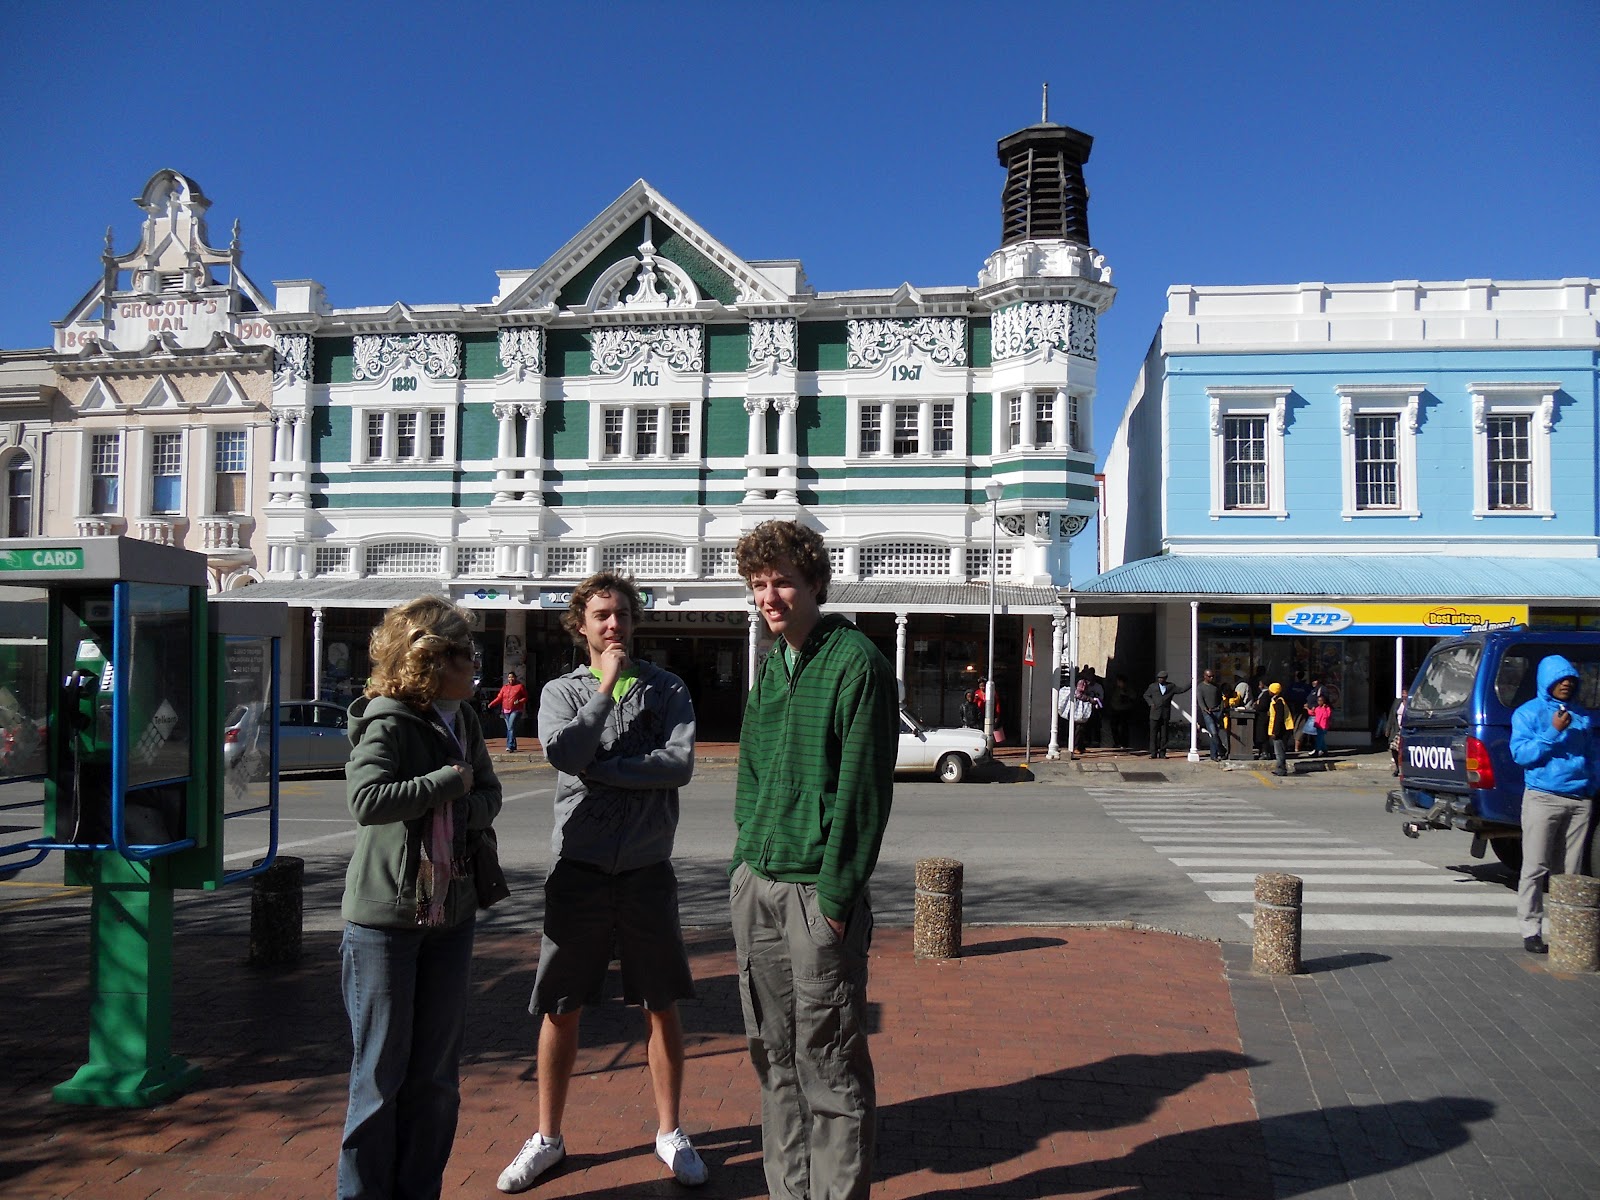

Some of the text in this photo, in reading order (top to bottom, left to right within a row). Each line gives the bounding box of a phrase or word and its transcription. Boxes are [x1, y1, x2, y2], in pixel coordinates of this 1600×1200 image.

[120, 299, 218, 319] GROCOTT'S
[148, 317, 188, 331] MAIL
[236, 322, 272, 340] 1906
[892, 364, 922, 381] 1907
[391, 376, 417, 391] 1880
[32, 551, 77, 566] CARD
[650, 611, 726, 623] CLICKS
[1291, 612, 1342, 626] PEP
[1429, 613, 1481, 625] Best prices
[1407, 746, 1455, 770] TOYOTA
